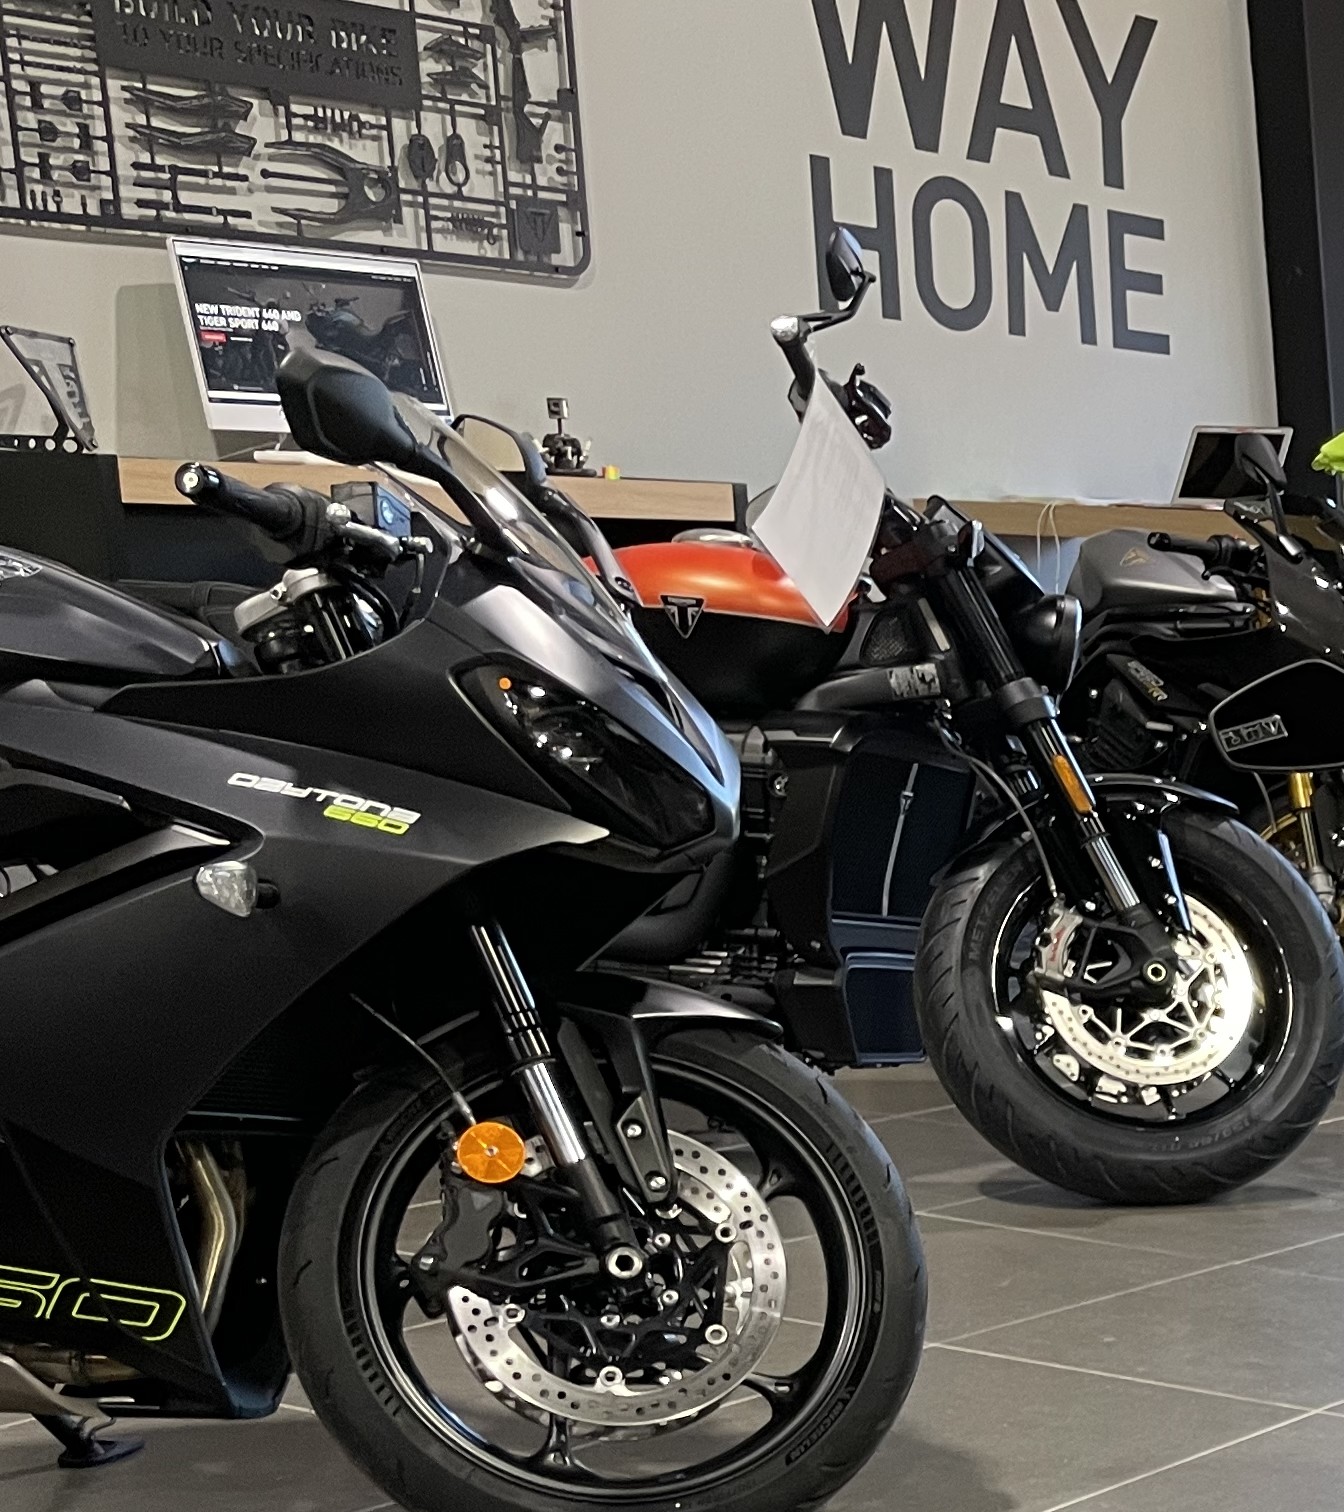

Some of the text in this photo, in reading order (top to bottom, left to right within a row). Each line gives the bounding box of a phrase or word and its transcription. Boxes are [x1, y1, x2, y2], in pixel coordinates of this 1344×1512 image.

[227, 1, 316, 44] YOUR
[329, 17, 398, 58] BIKE
[811, 0, 1158, 190] WAY
[809, 154, 1171, 356] HOME
[194, 303, 219, 315] NEW
[219, 304, 260, 318] TRIDENT
[227, 772, 421, 825] DAYTONA
[323, 804, 410, 835] 660
